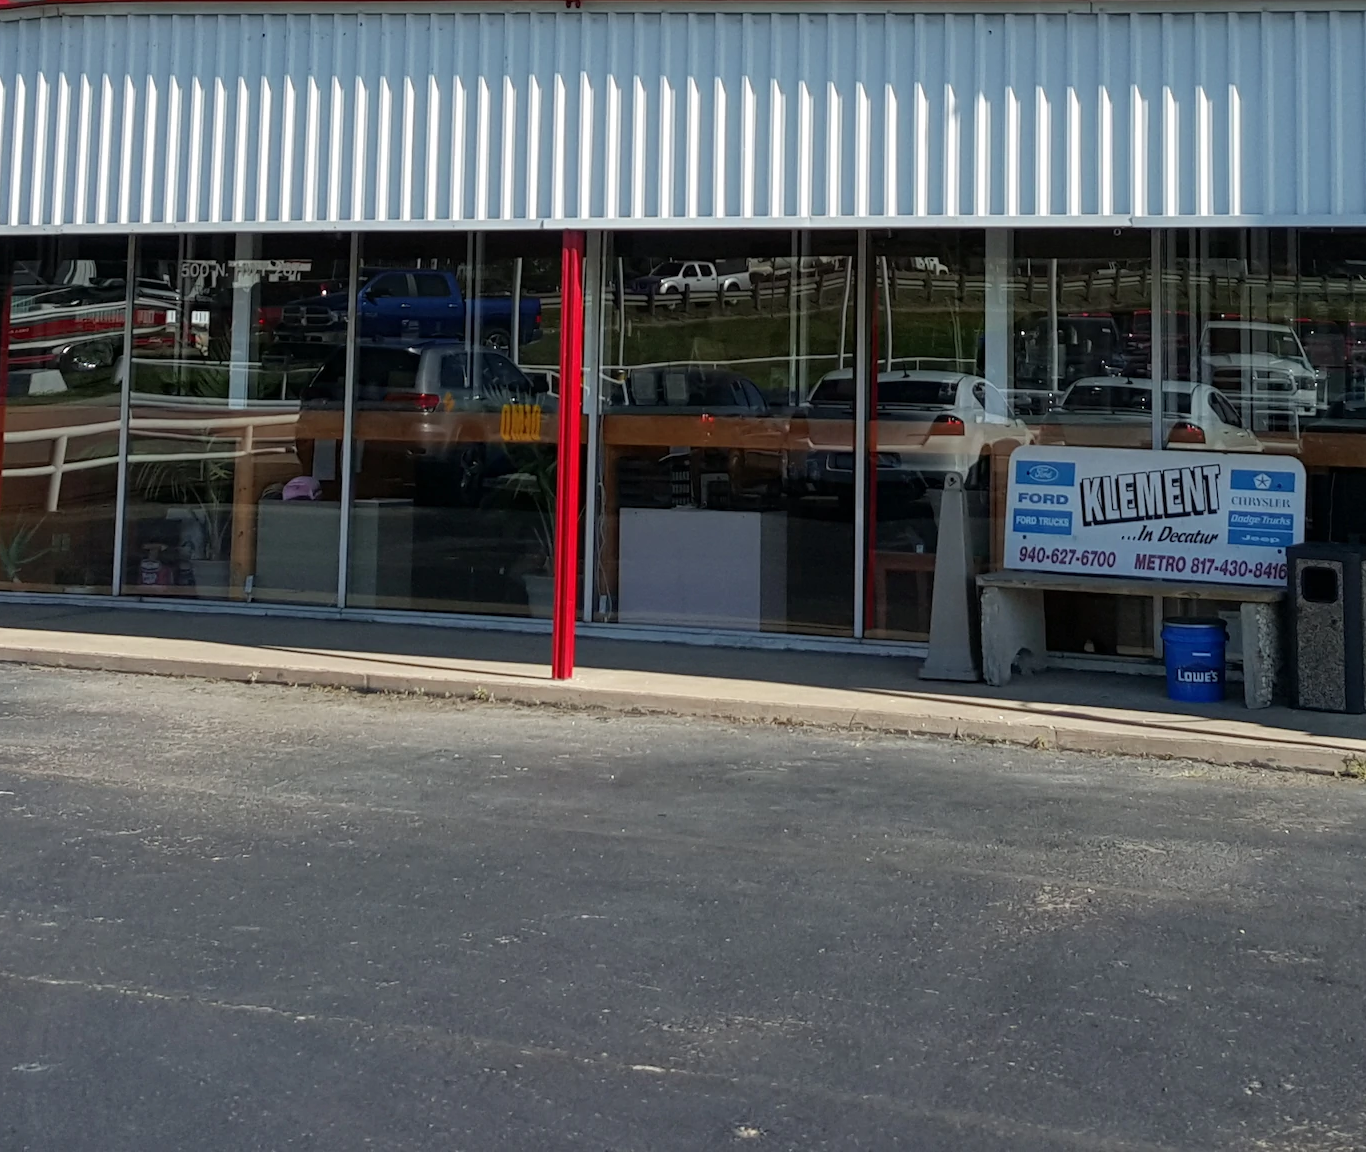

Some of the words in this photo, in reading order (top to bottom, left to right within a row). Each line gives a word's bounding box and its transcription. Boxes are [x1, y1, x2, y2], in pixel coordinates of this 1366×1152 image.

[181, 263, 209, 277] 500
[1018, 492, 1069, 505] FORD
[1079, 464, 1221, 527] KLEMENT
[1231, 496, 1291, 508] CHRYSLER
[1016, 515, 1037, 525] FORD
[1039, 517, 1069, 527] TRUCKS
[1230, 514, 1261, 525] Dodge
[1262, 516, 1291, 526] Trucks
[1157, 526, 1219, 545] Decatur
[1241, 534, 1281, 544] Jeep
[1019, 546, 1117, 568] 940-627-6700
[1134, 553, 1186, 573] METRO
[1191, 557, 1288, 580] 817-430-8416
[1177, 668, 1219, 683] LOWE'S
